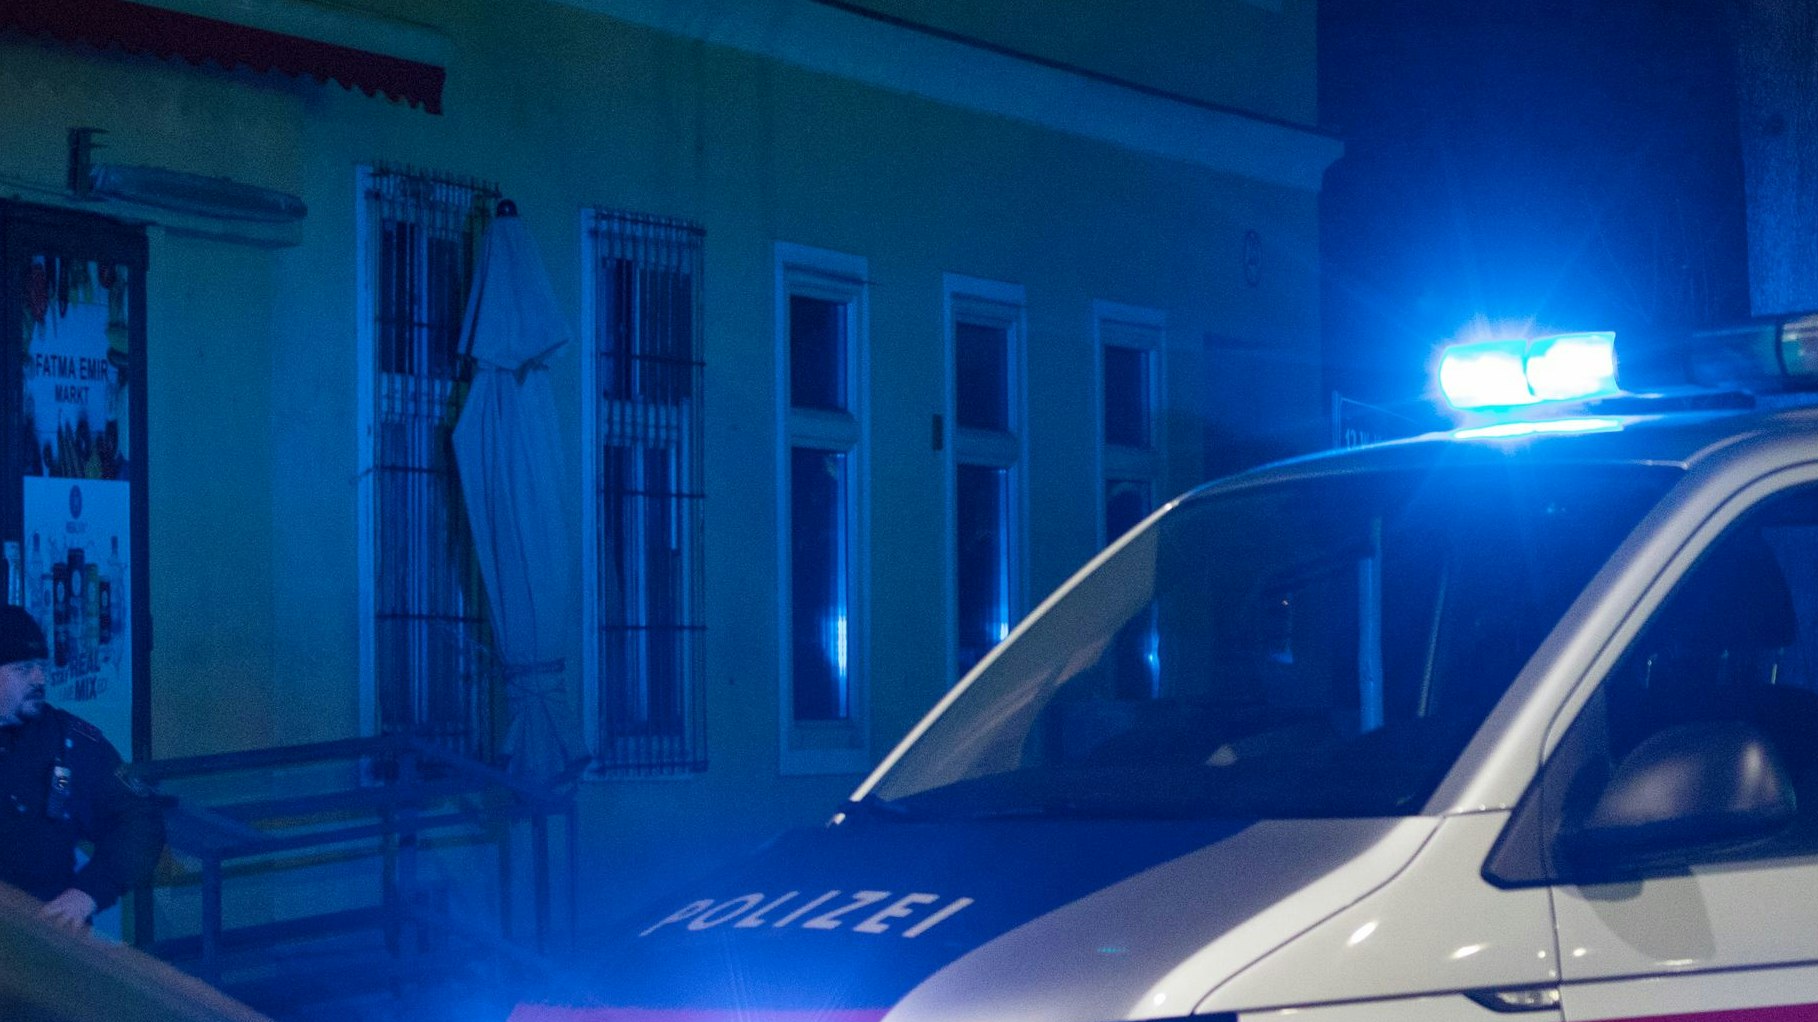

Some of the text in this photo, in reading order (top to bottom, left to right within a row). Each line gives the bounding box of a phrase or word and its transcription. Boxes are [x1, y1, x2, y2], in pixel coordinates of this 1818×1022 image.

[35, 353, 109, 382] FATMA EMIR
[55, 384, 89, 404] MARKT
[638, 890, 975, 939] POLIZEI
